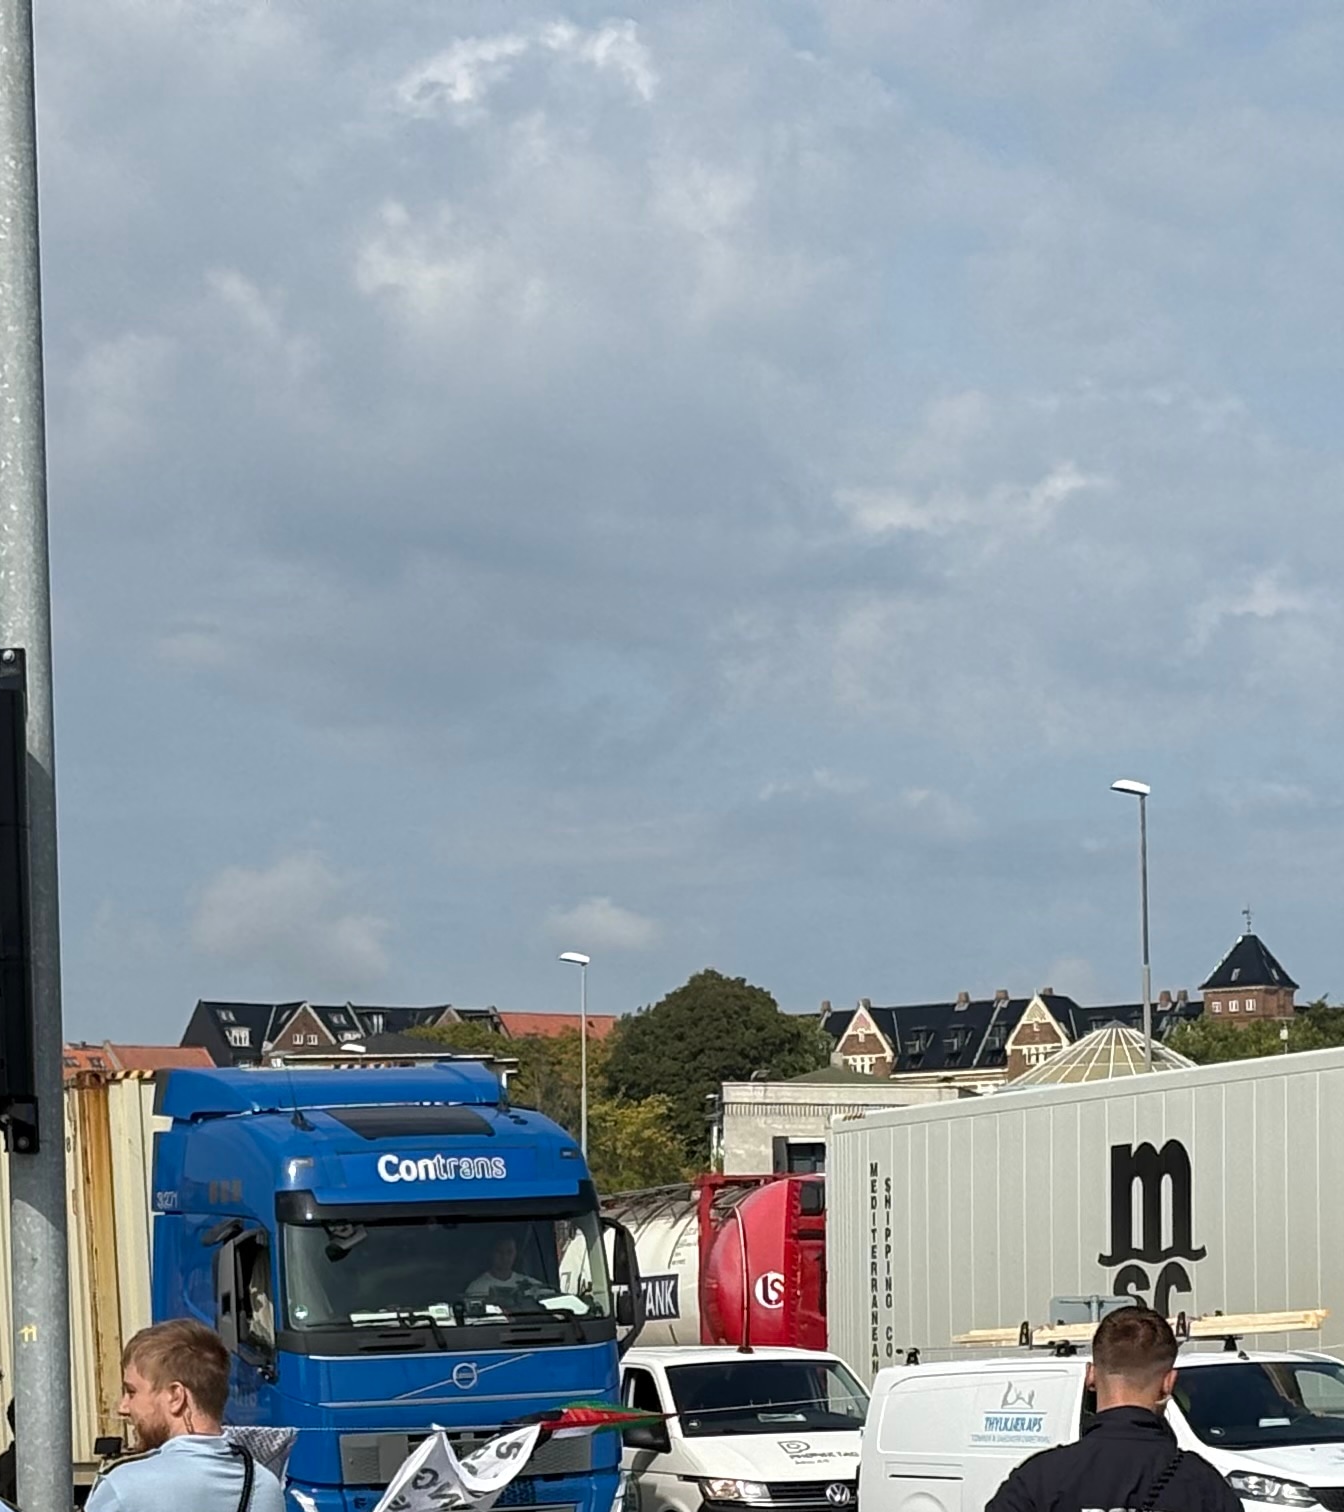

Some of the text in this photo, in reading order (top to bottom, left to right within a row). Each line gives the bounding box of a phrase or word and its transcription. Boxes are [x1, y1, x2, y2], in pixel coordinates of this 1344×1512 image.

[377, 1152, 507, 1183] Contrans
[869, 1162, 880, 1374] MEDITERRANEAN
[884, 1177, 894, 1358] SHIPPING CO
